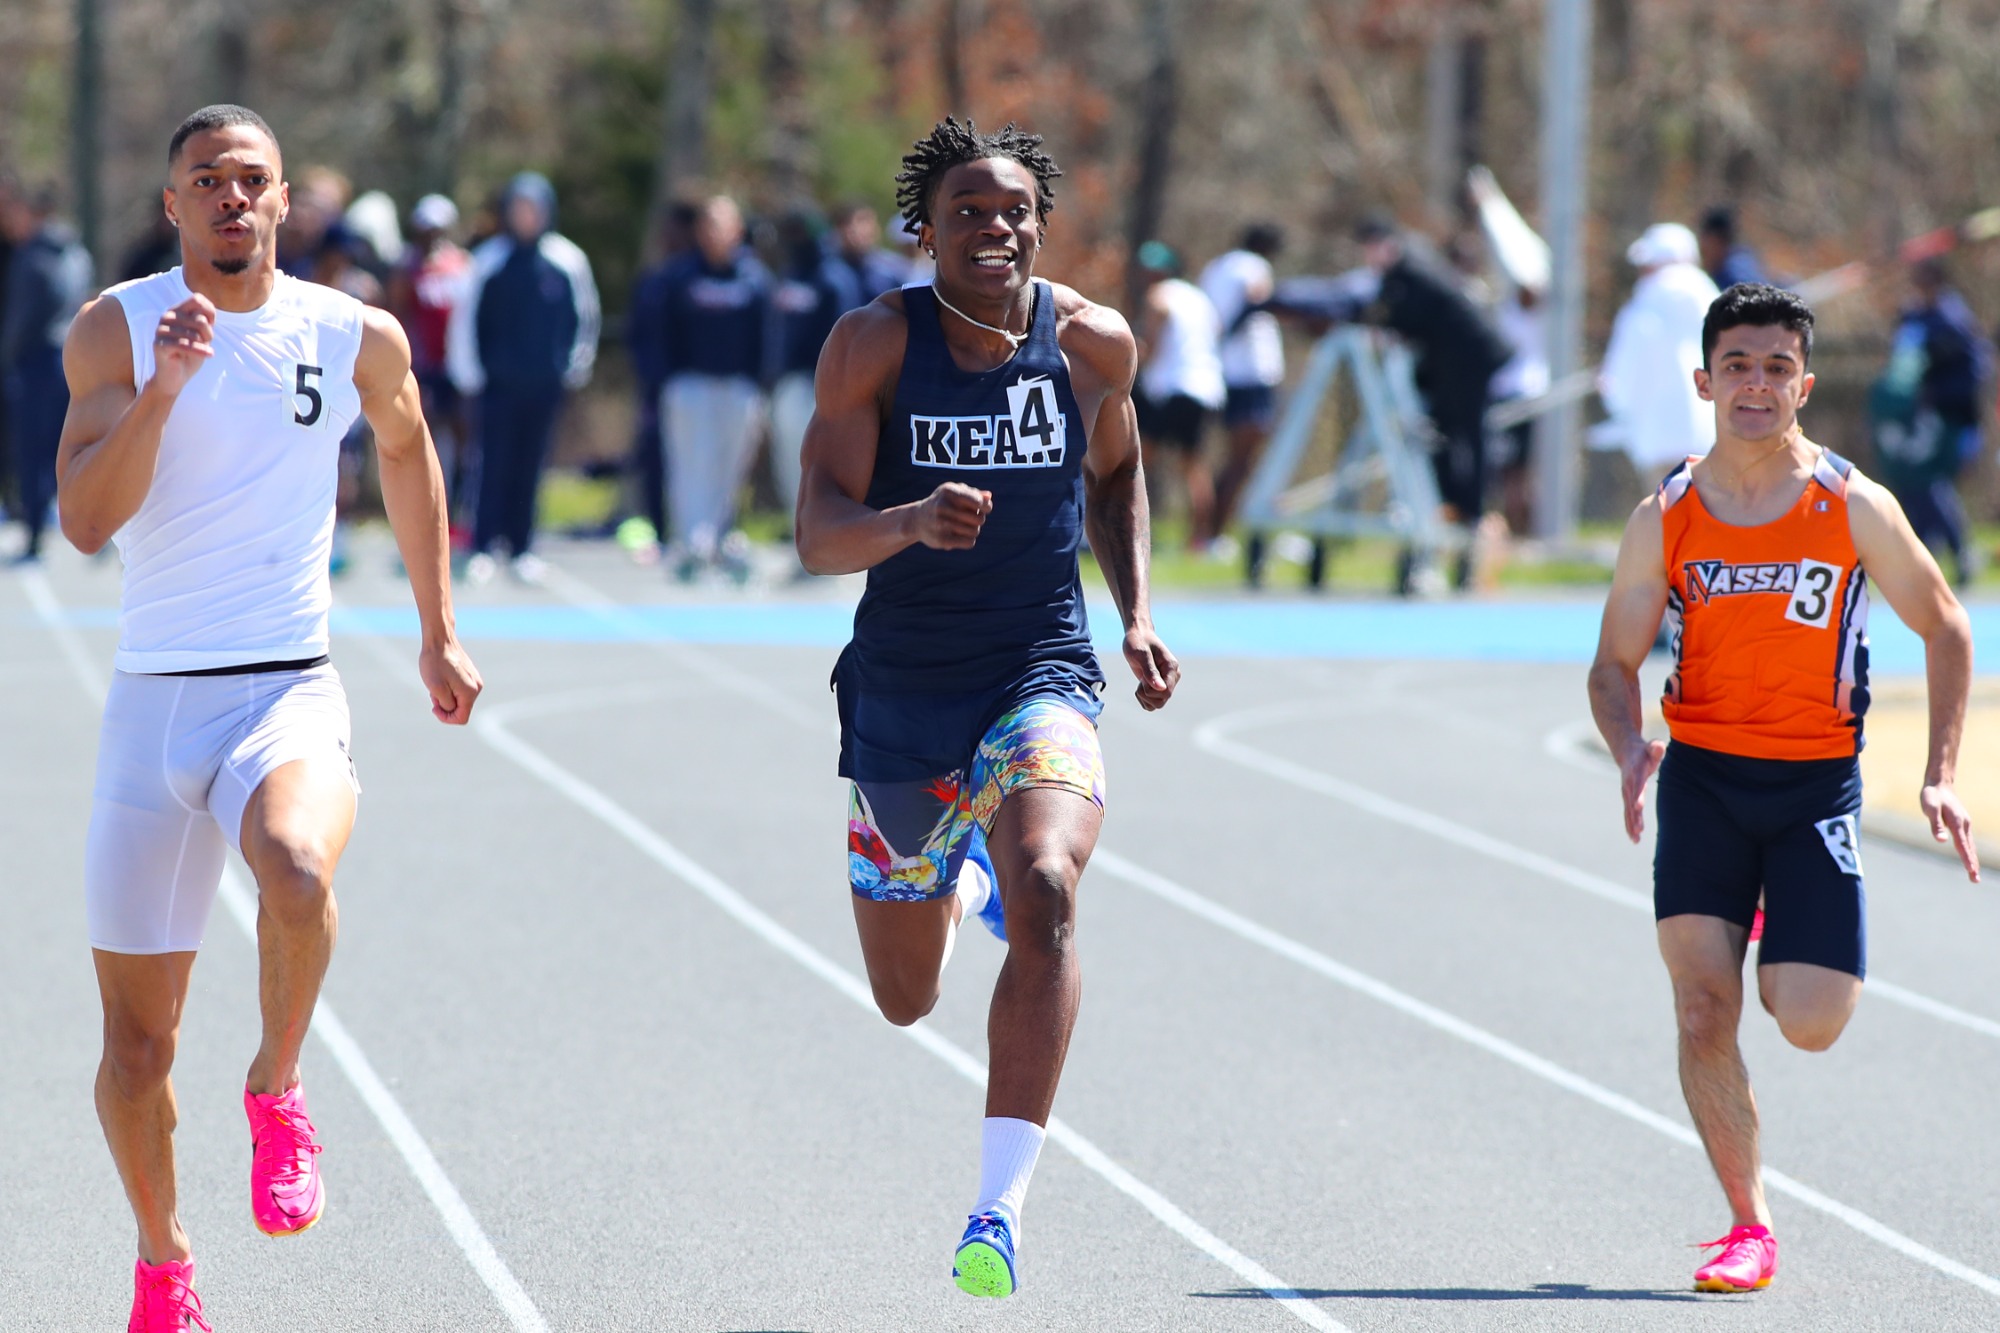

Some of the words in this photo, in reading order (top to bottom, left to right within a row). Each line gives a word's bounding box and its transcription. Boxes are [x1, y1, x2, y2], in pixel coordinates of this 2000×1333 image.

[294, 363, 323, 427] 5
[1019, 386, 1054, 446] 4
[1683, 559, 1800, 606] NASSA
[1795, 566, 1833, 621] 3
[1827, 820, 1857, 870] 3
